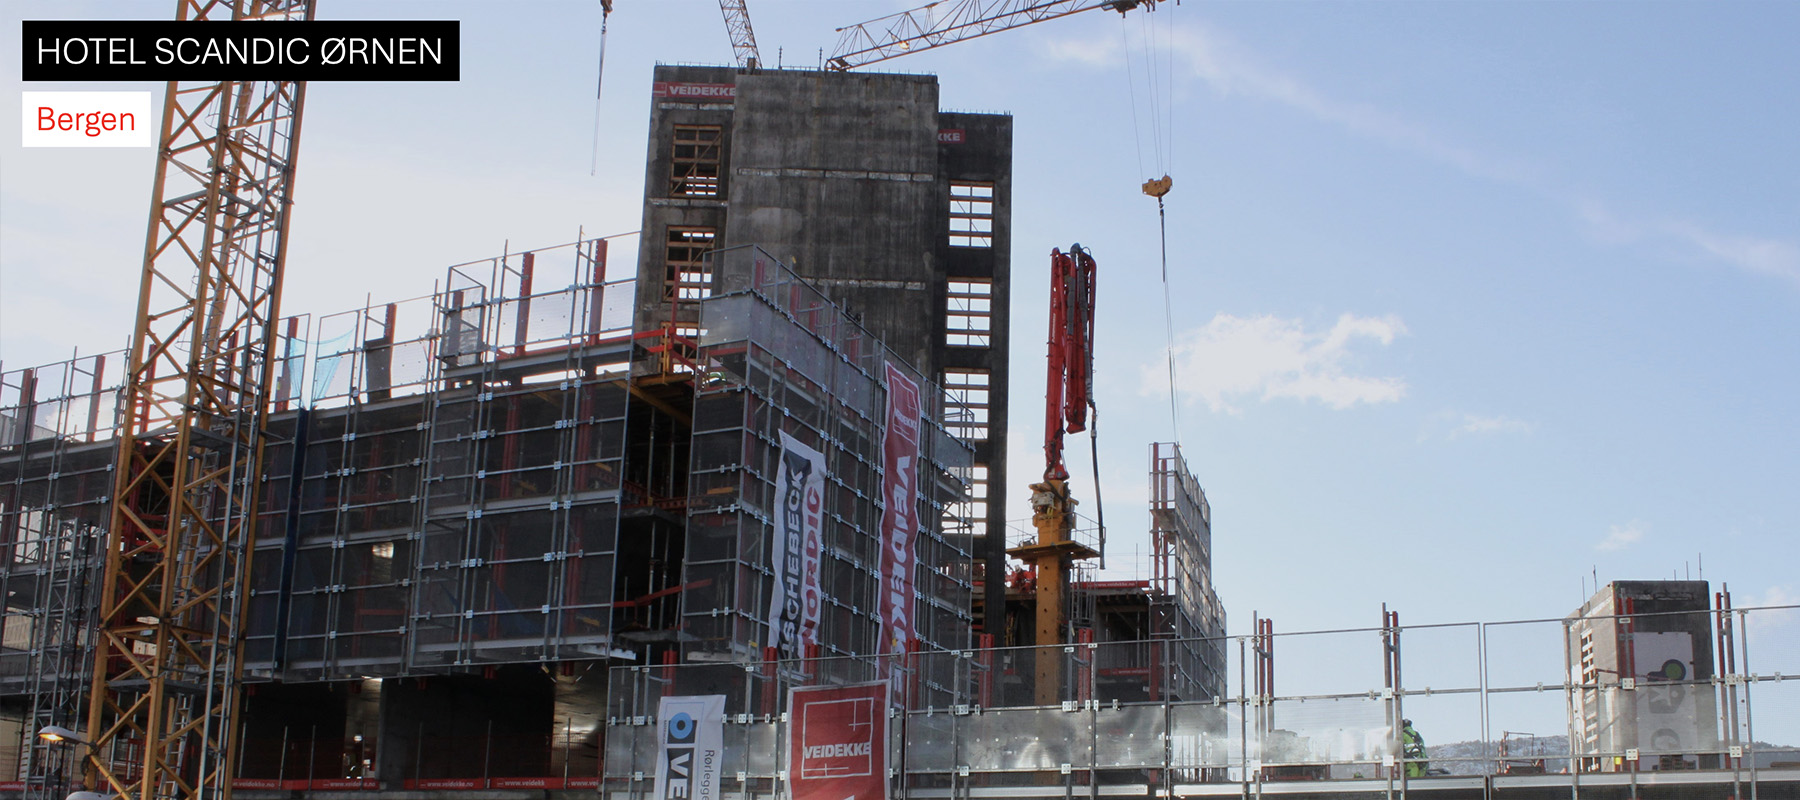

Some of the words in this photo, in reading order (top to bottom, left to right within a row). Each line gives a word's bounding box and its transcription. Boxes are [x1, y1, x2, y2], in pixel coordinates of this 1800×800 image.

[669, 86, 737, 97] VEIDEKKE
[802, 486, 820, 645] NORDIC
[804, 742, 871, 759] VEIDEKKE
